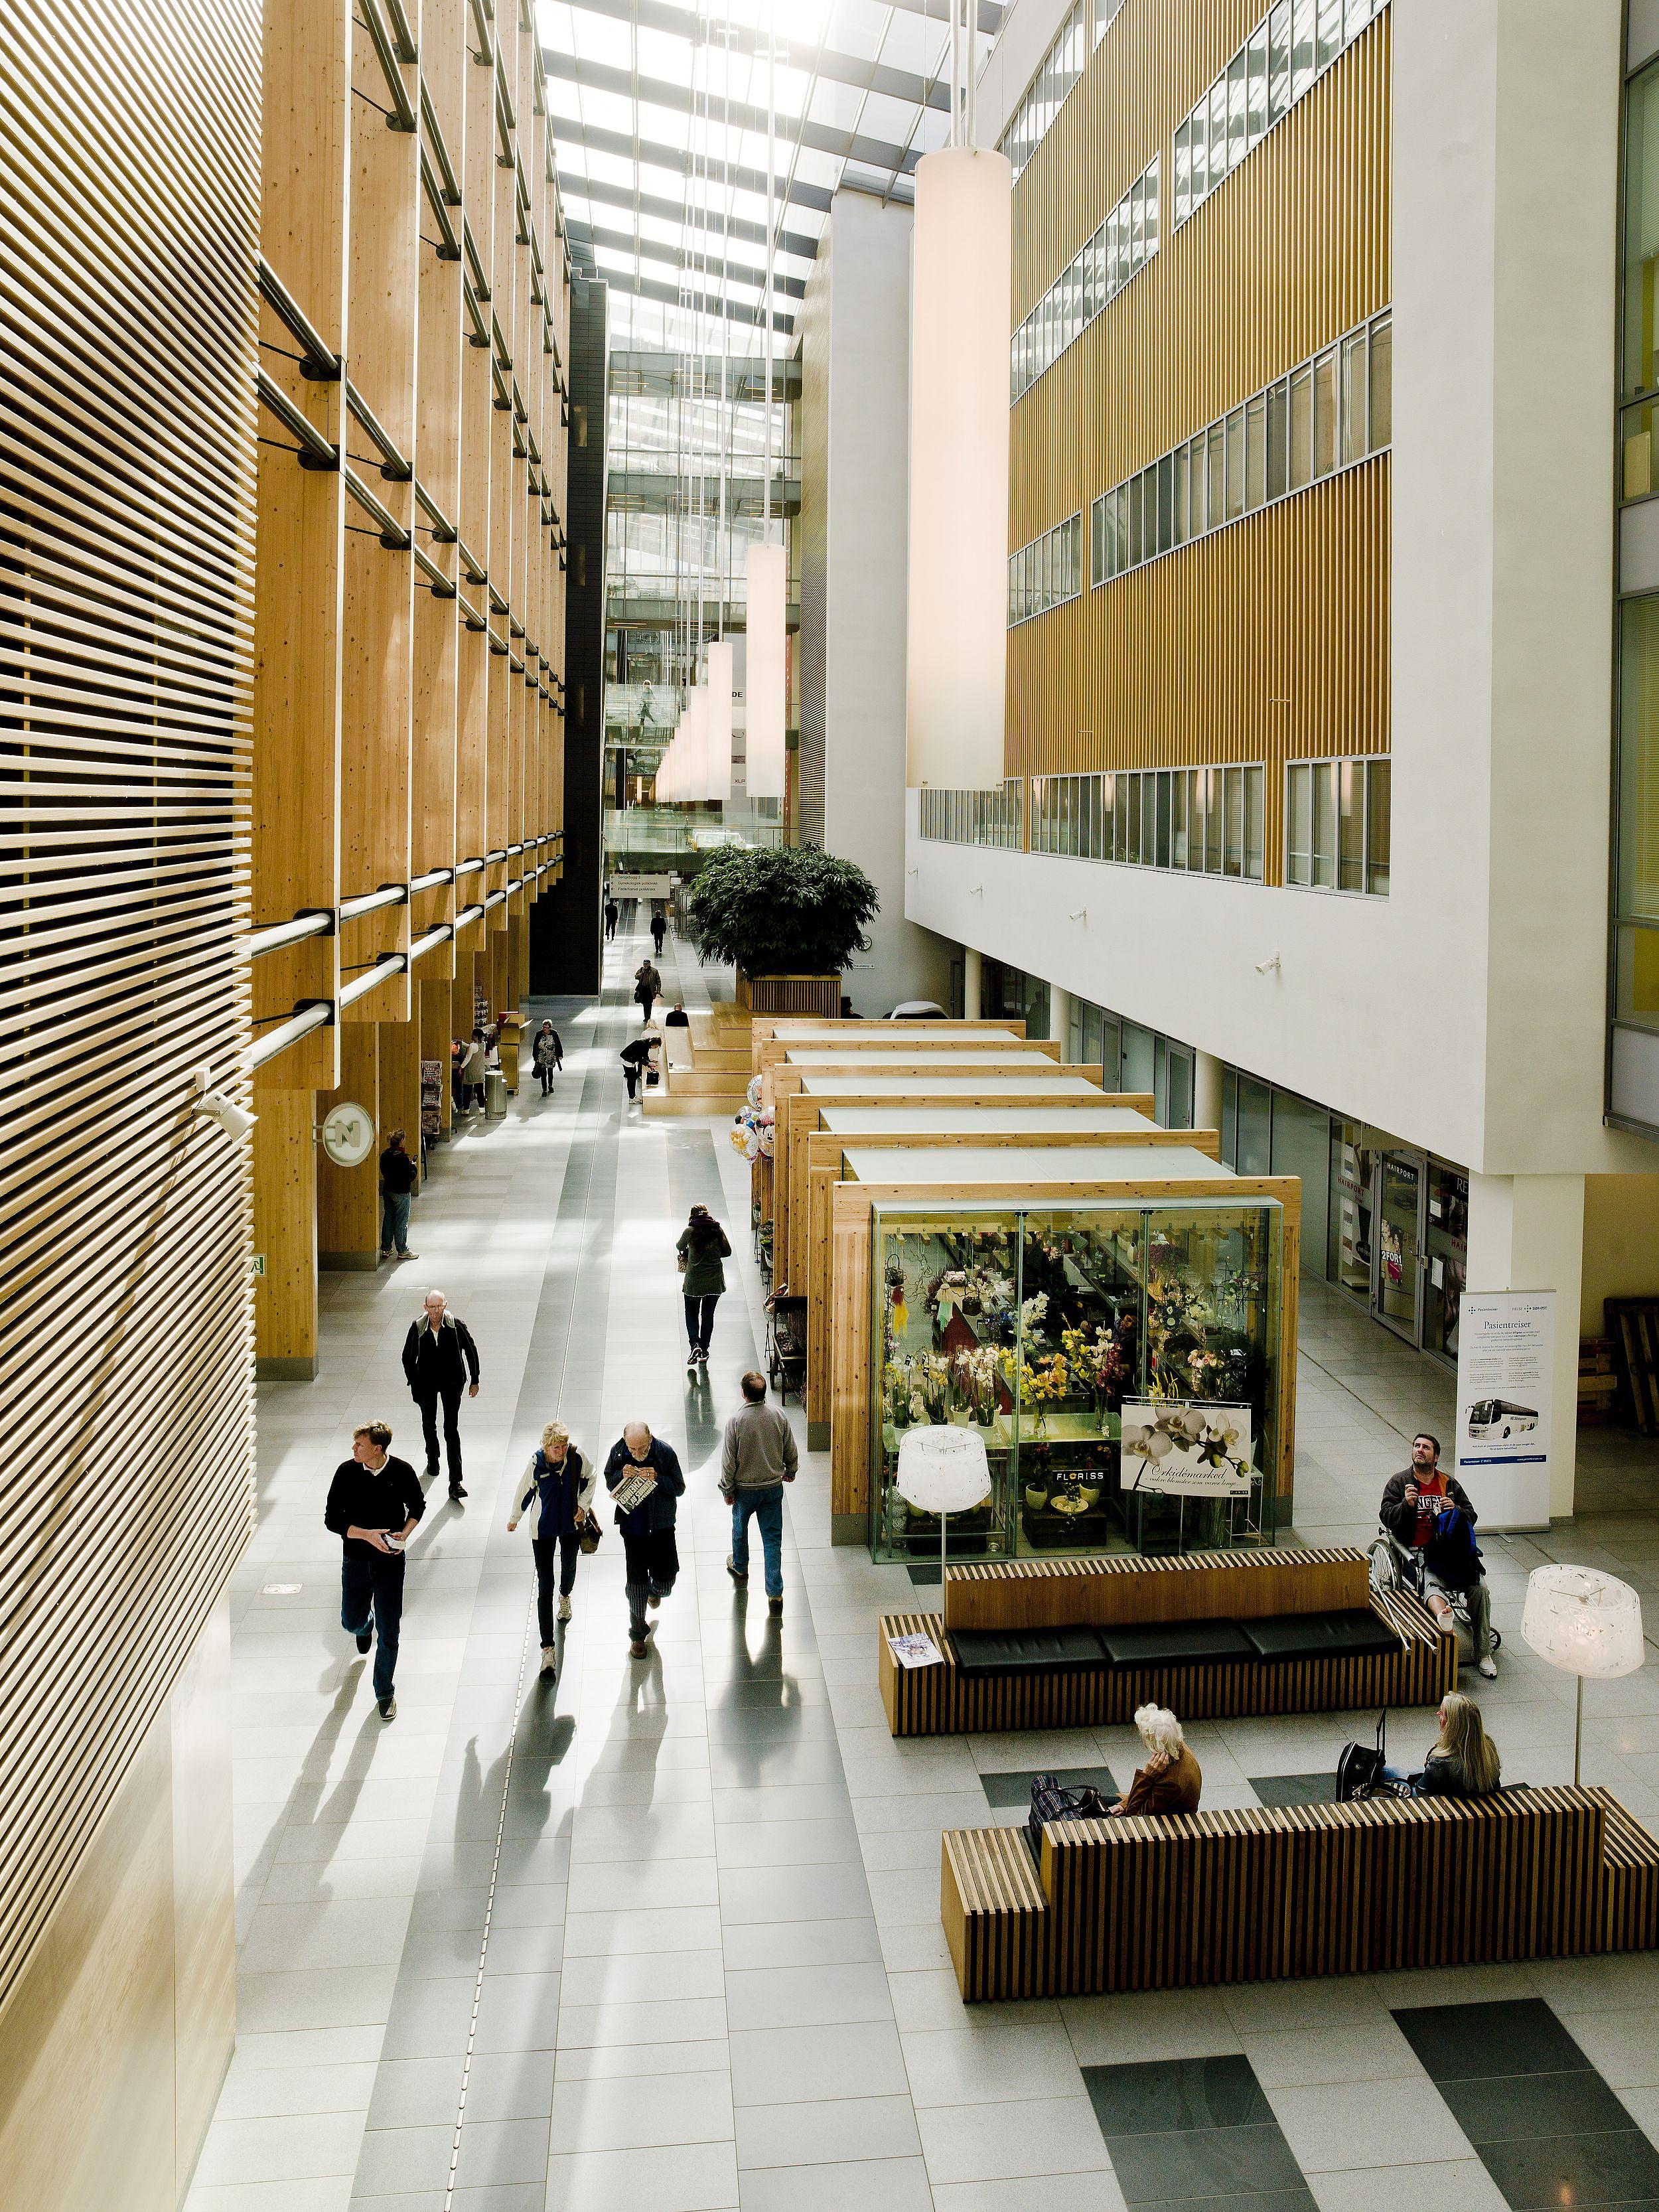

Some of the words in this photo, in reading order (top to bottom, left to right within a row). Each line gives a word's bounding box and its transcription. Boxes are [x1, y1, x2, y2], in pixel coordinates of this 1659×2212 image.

[335, 1120, 360, 1147] N
[1387, 1162, 1414, 1180] HAIRPORT
[1337, 1176, 1364, 1196] HAIRPORT
[1382, 1250, 1402, 1264] 2FOR1
[1484, 1319, 1532, 1329] Pasientreiser
[1151, 1464, 1227, 1479] Orkidémarked
[618, 1475, 645, 1505] LZHEIMER
